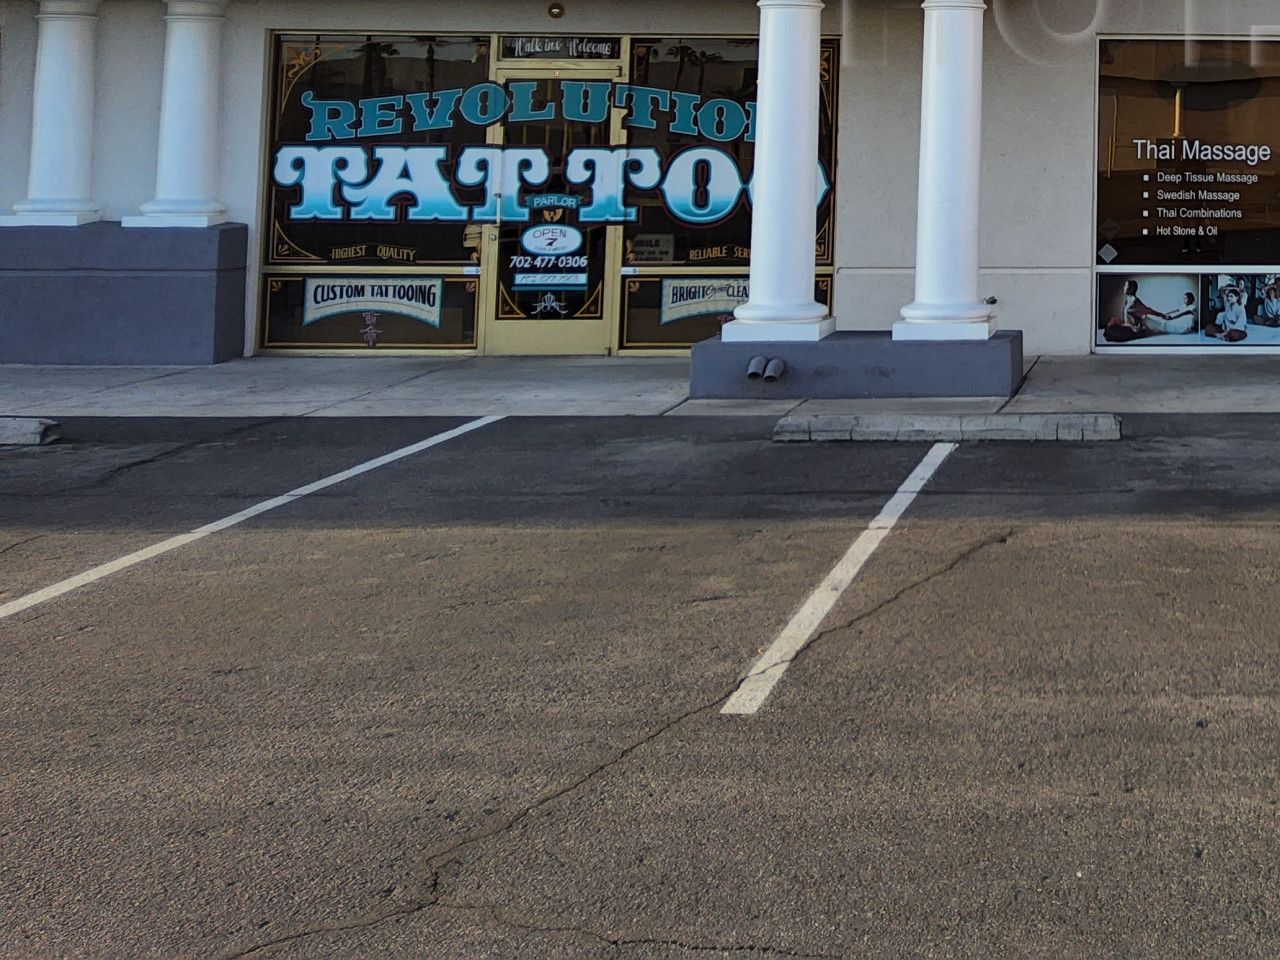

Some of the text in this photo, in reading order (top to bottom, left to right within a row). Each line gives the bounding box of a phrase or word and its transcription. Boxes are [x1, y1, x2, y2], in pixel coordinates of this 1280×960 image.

[1132, 139, 1271, 166] Thai Massage
[1157, 172, 1258, 185] Deep Tissue Massage
[533, 195, 577, 207] PARLOR
[1157, 190, 1240, 202] Swedish Massage
[1156, 208, 1242, 219] Thai Combinations
[532, 228, 567, 239] OPEN
[1156, 226, 1218, 236] Hot Stone & Oil
[545, 237, 558, 247] 7
[331, 244, 417, 261] HIGHEST QUALITY
[689, 245, 728, 260] RELIABLE
[313, 284, 437, 307] CUSTOM TATTOOING
[671, 285, 706, 304] BRIGHT
